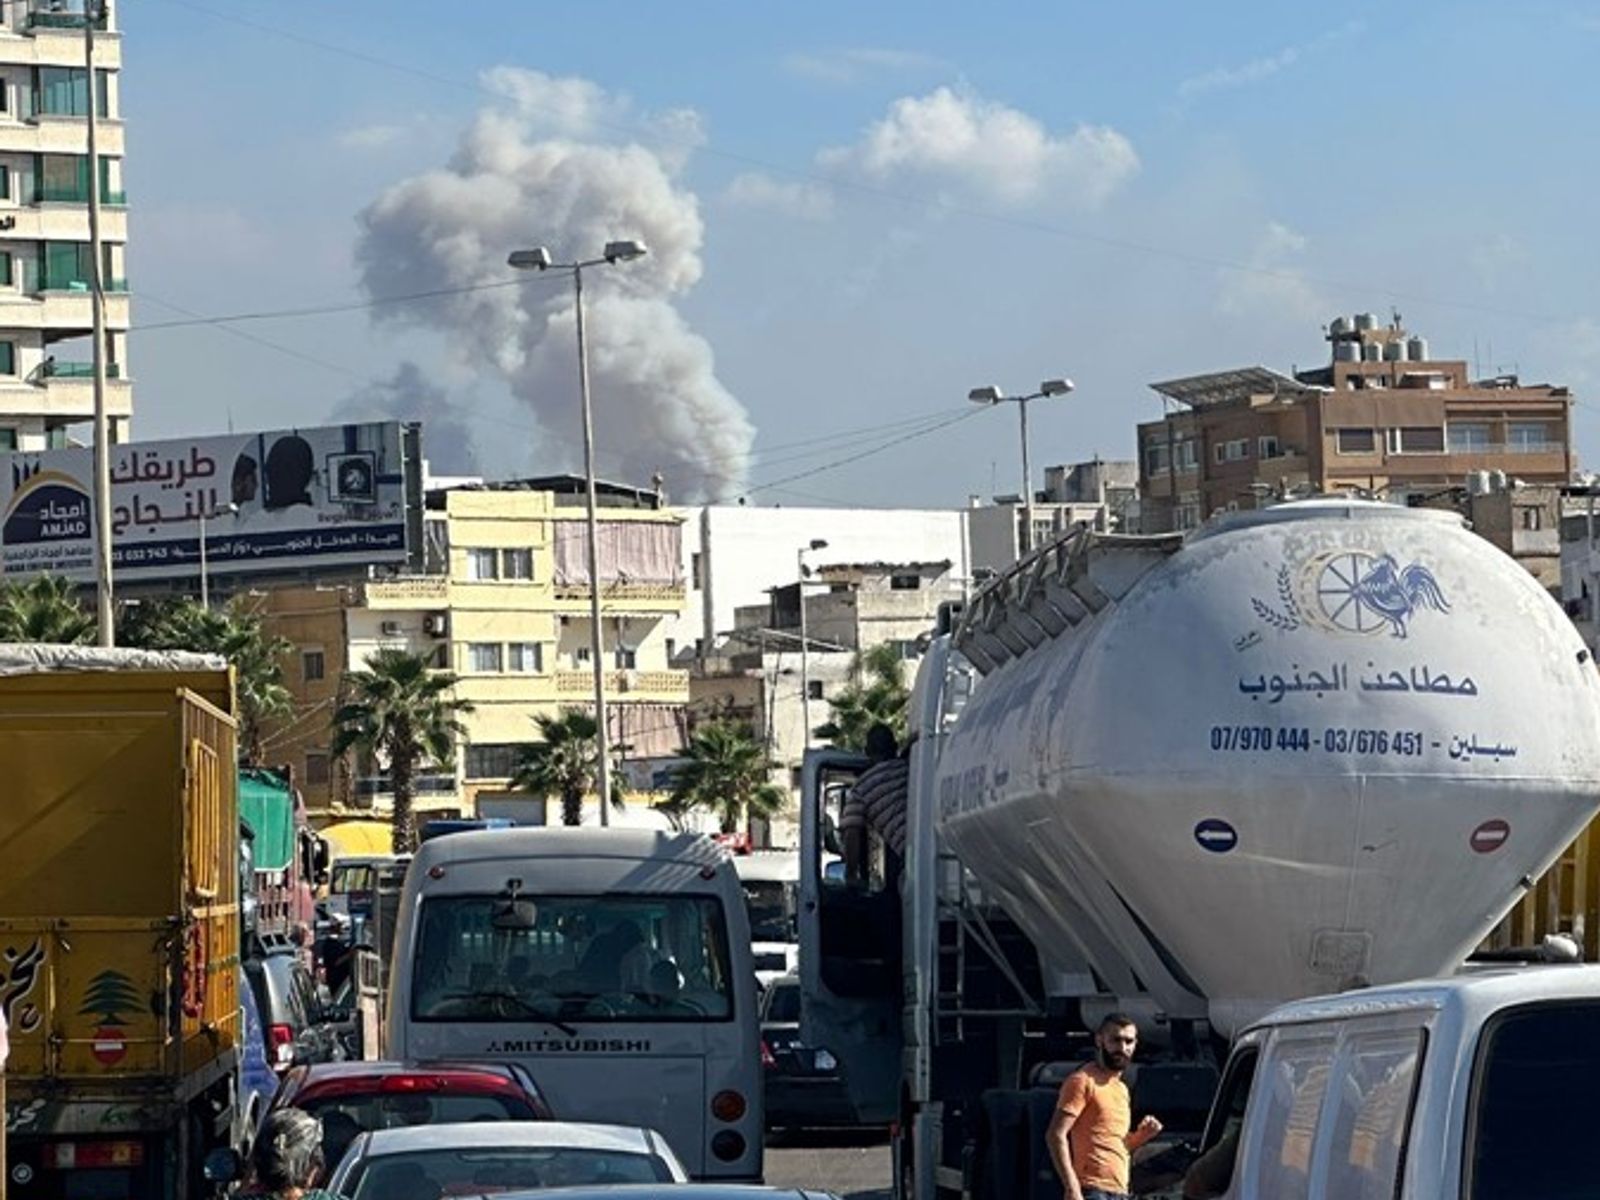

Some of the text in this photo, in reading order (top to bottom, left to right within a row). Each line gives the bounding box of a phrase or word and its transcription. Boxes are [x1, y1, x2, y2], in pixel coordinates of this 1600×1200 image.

[110, 447, 215, 489] طريقك
[112, 488, 217, 535] للنجاح
[1239, 661, 1478, 703] مطاحن الجنوب
[1211, 726, 1272, 751] 07/970
[1277, 727, 1311, 751] 444
[1324, 728, 1388, 754] 03/676
[1392, 731, 1423, 755] 451
[1449, 733, 1518, 763] سبلين
[503, 1039, 650, 1052] MITSUBISHI
